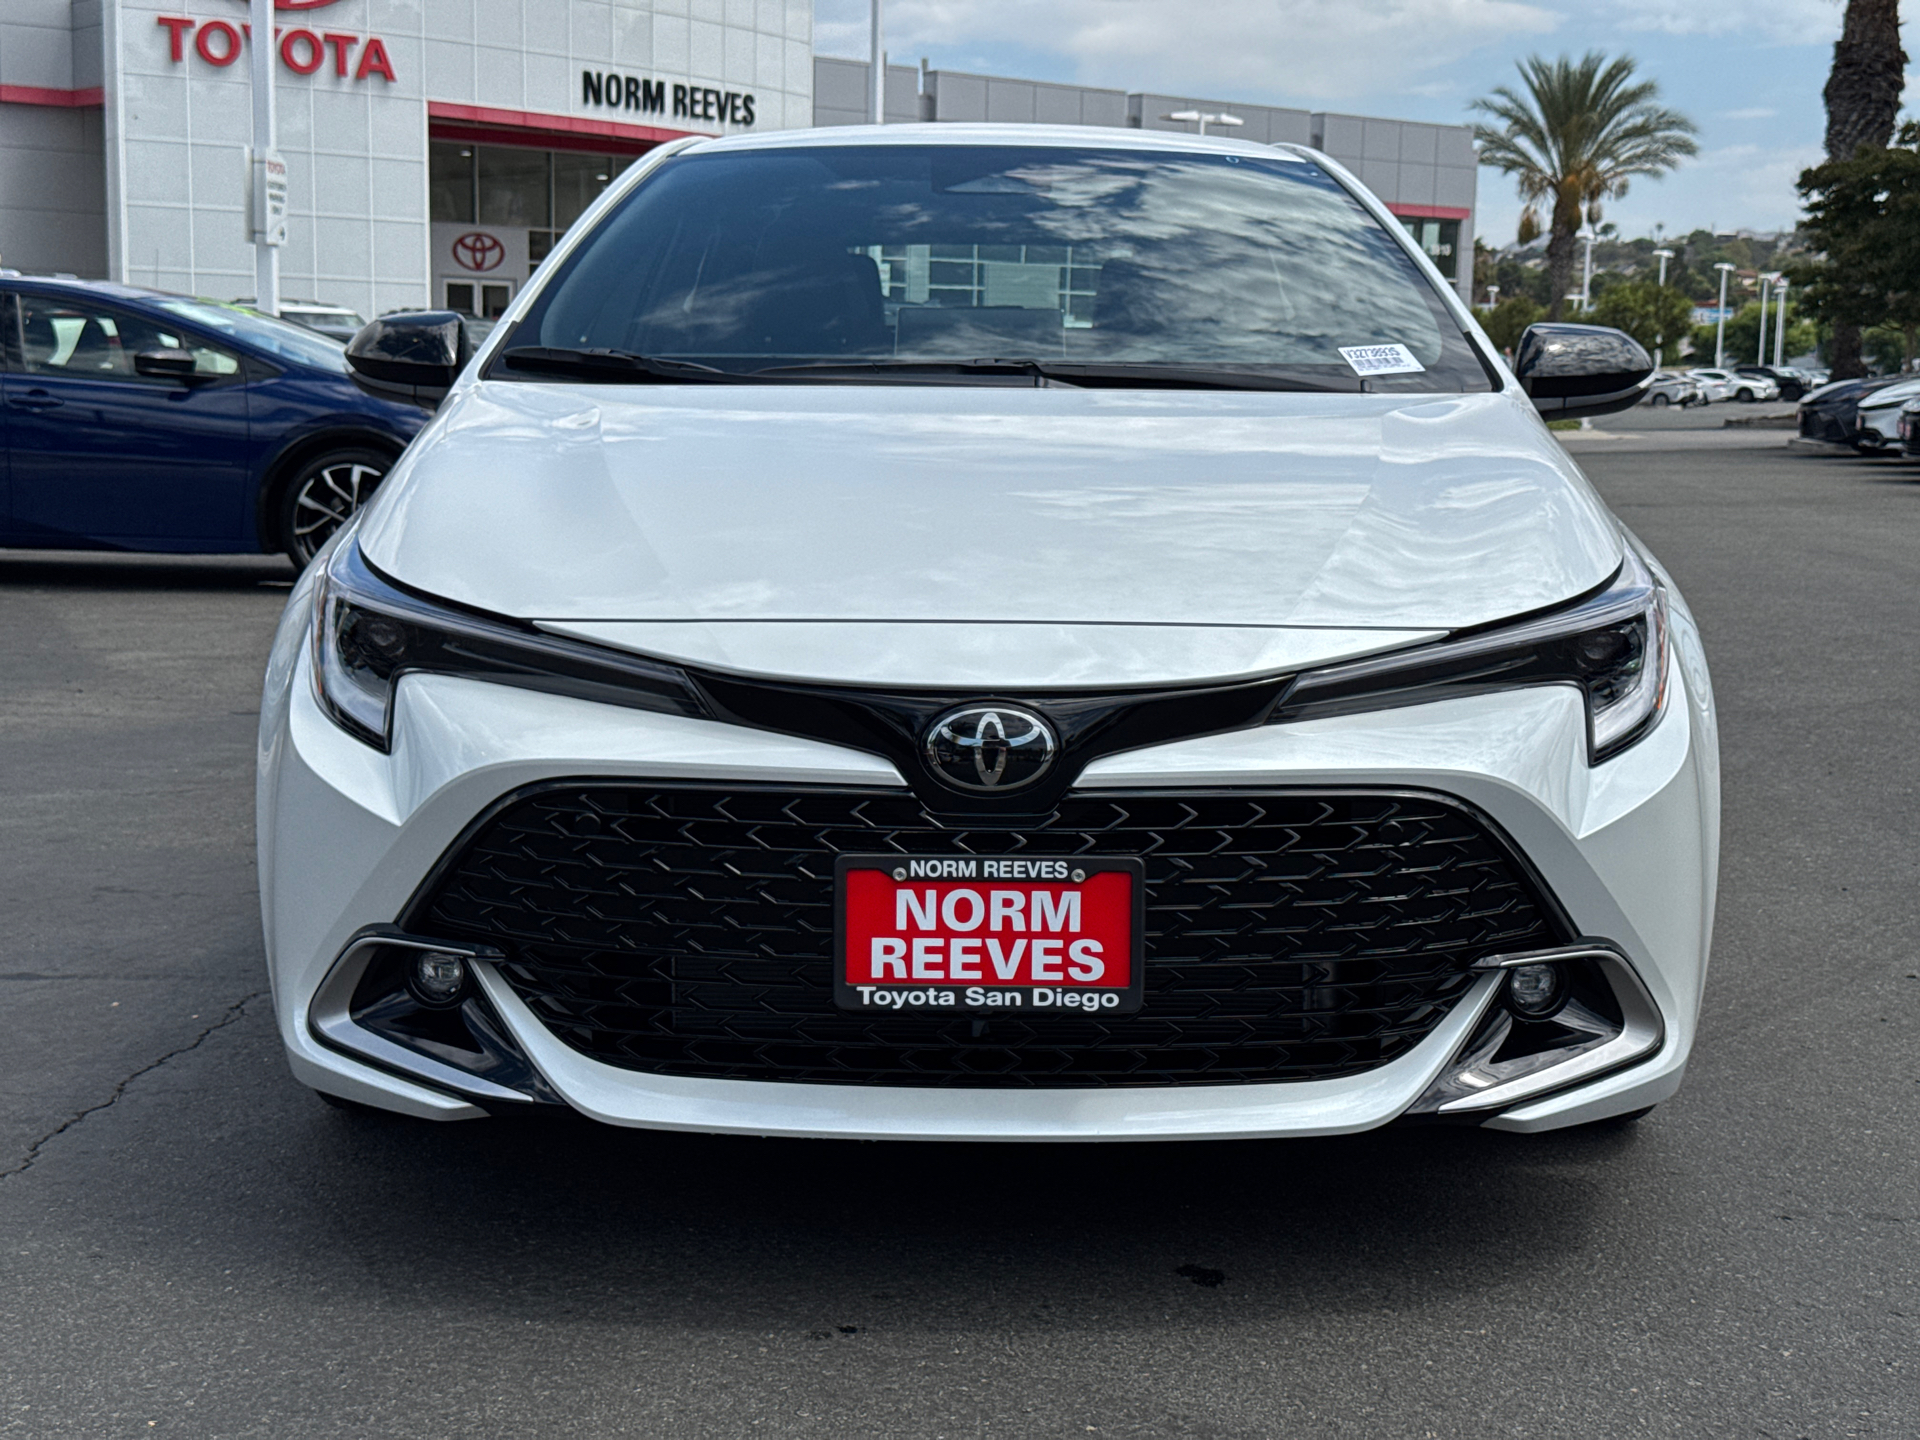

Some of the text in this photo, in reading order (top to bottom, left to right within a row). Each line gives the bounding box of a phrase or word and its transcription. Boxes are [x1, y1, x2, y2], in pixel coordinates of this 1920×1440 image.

[157, 16, 396, 82] TOOTA
[582, 70, 756, 126] NORM REEVES
[910, 860, 1068, 879] NORM REEVES
[895, 888, 1081, 933] NORM
[871, 937, 1105, 982] REEVES
[857, 986, 1120, 1011] Toyota San Diego
